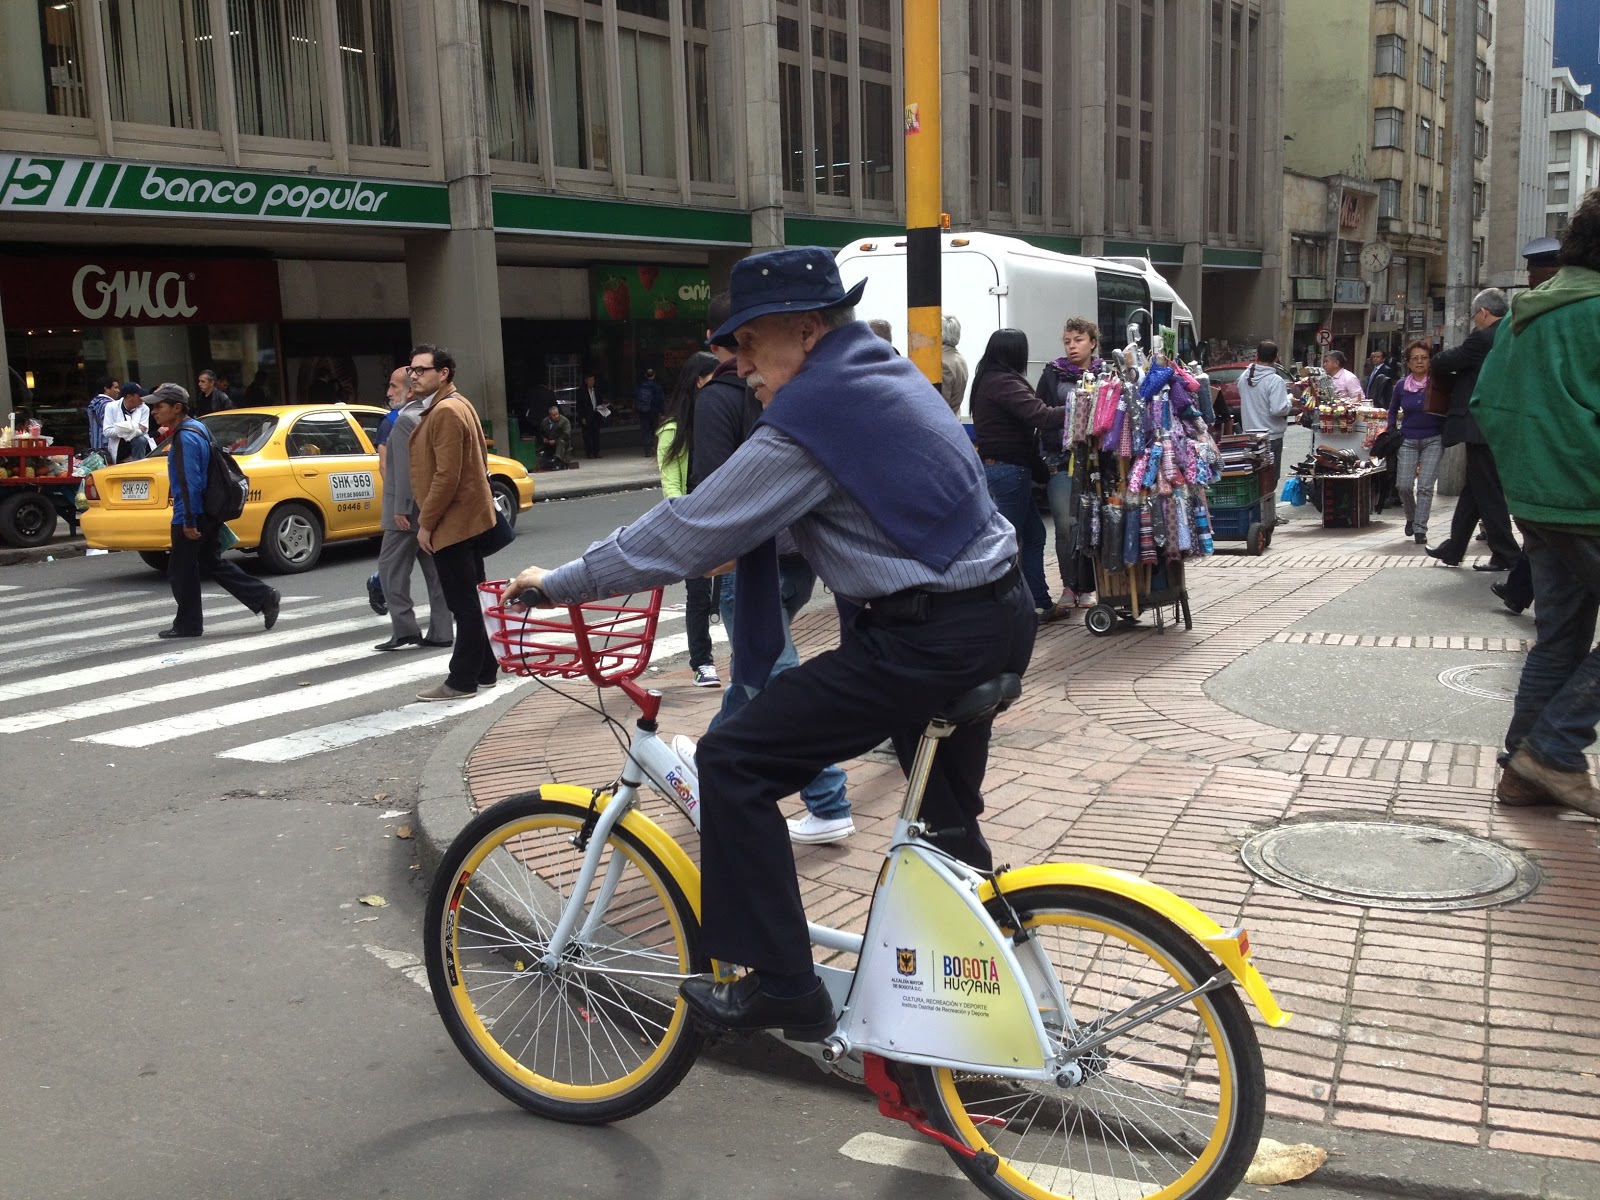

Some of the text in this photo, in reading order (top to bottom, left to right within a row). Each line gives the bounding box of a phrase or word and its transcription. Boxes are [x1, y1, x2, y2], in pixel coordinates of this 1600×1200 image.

[140, 167, 388, 217] banco popular
[332, 474, 371, 489] SHK 969
[943, 955, 999, 982] BOGOTÁ
[963, 1002, 988, 1011] DEPORTE
